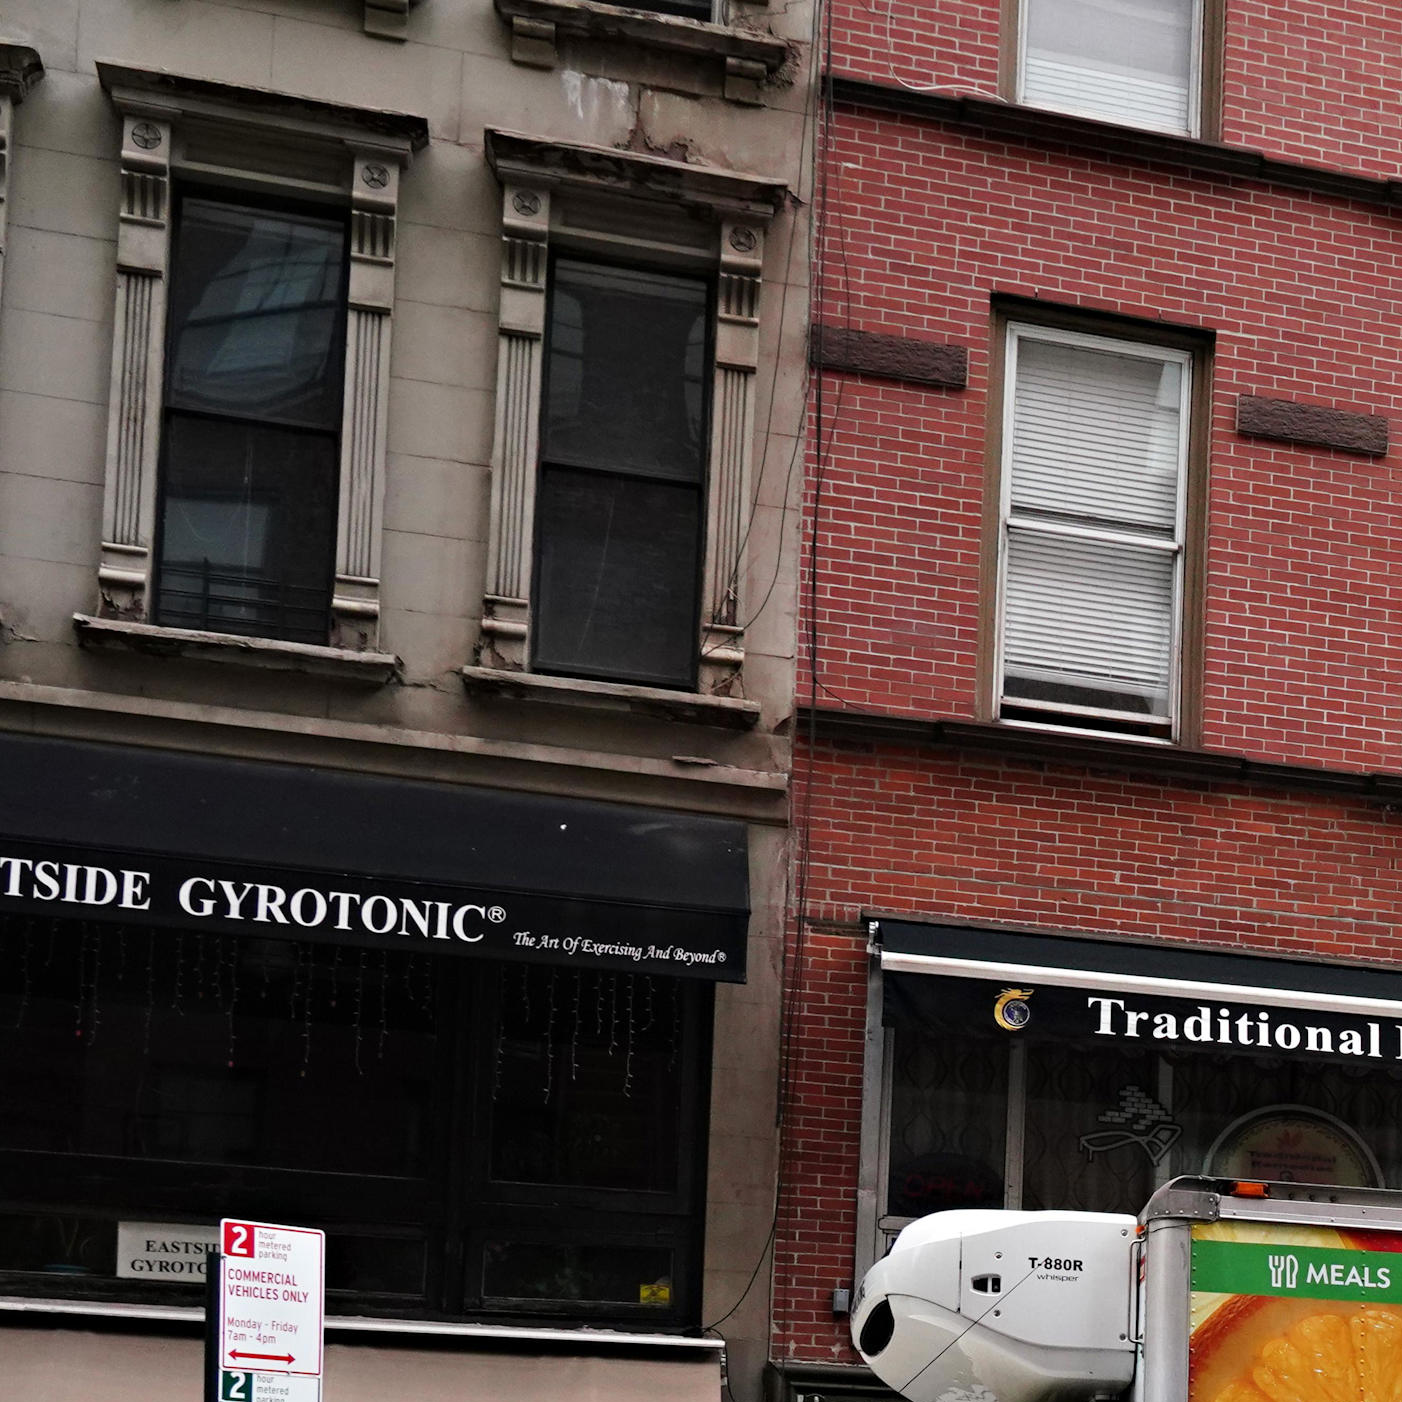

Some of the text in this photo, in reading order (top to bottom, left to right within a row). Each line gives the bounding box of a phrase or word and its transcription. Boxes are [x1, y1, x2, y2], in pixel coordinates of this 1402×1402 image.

[513, 931, 536, 946] The
[536, 935, 559, 949] Art
[563, 937, 581, 955] Of
[581, 938, 642, 961] Exercising
[643, 945, 673, 960] And
[1087, 997, 1382, 1059] Traditional
[232, 1226, 276, 1254] 2 hour
[258, 1241, 291, 1251] metered
[259, 1251, 287, 1262] parking
[1028, 1257, 1083, 1272] T-880R
[228, 1269, 298, 1286] COMMERCIAL
[1036, 1273, 1079, 1283] whisper
[1305, 1263, 1391, 1289] MEALS
[228, 1285, 309, 1303] VEHICLES ONLY
[228, 1318, 262, 1332] Monday
[271, 1321, 298, 1334] Friday
[228, 1330, 246, 1341] 7am
[256, 1334, 276, 1345] 4pm
[230, 1372, 274, 1399] 2 hour
[256, 1385, 289, 1395] metered
